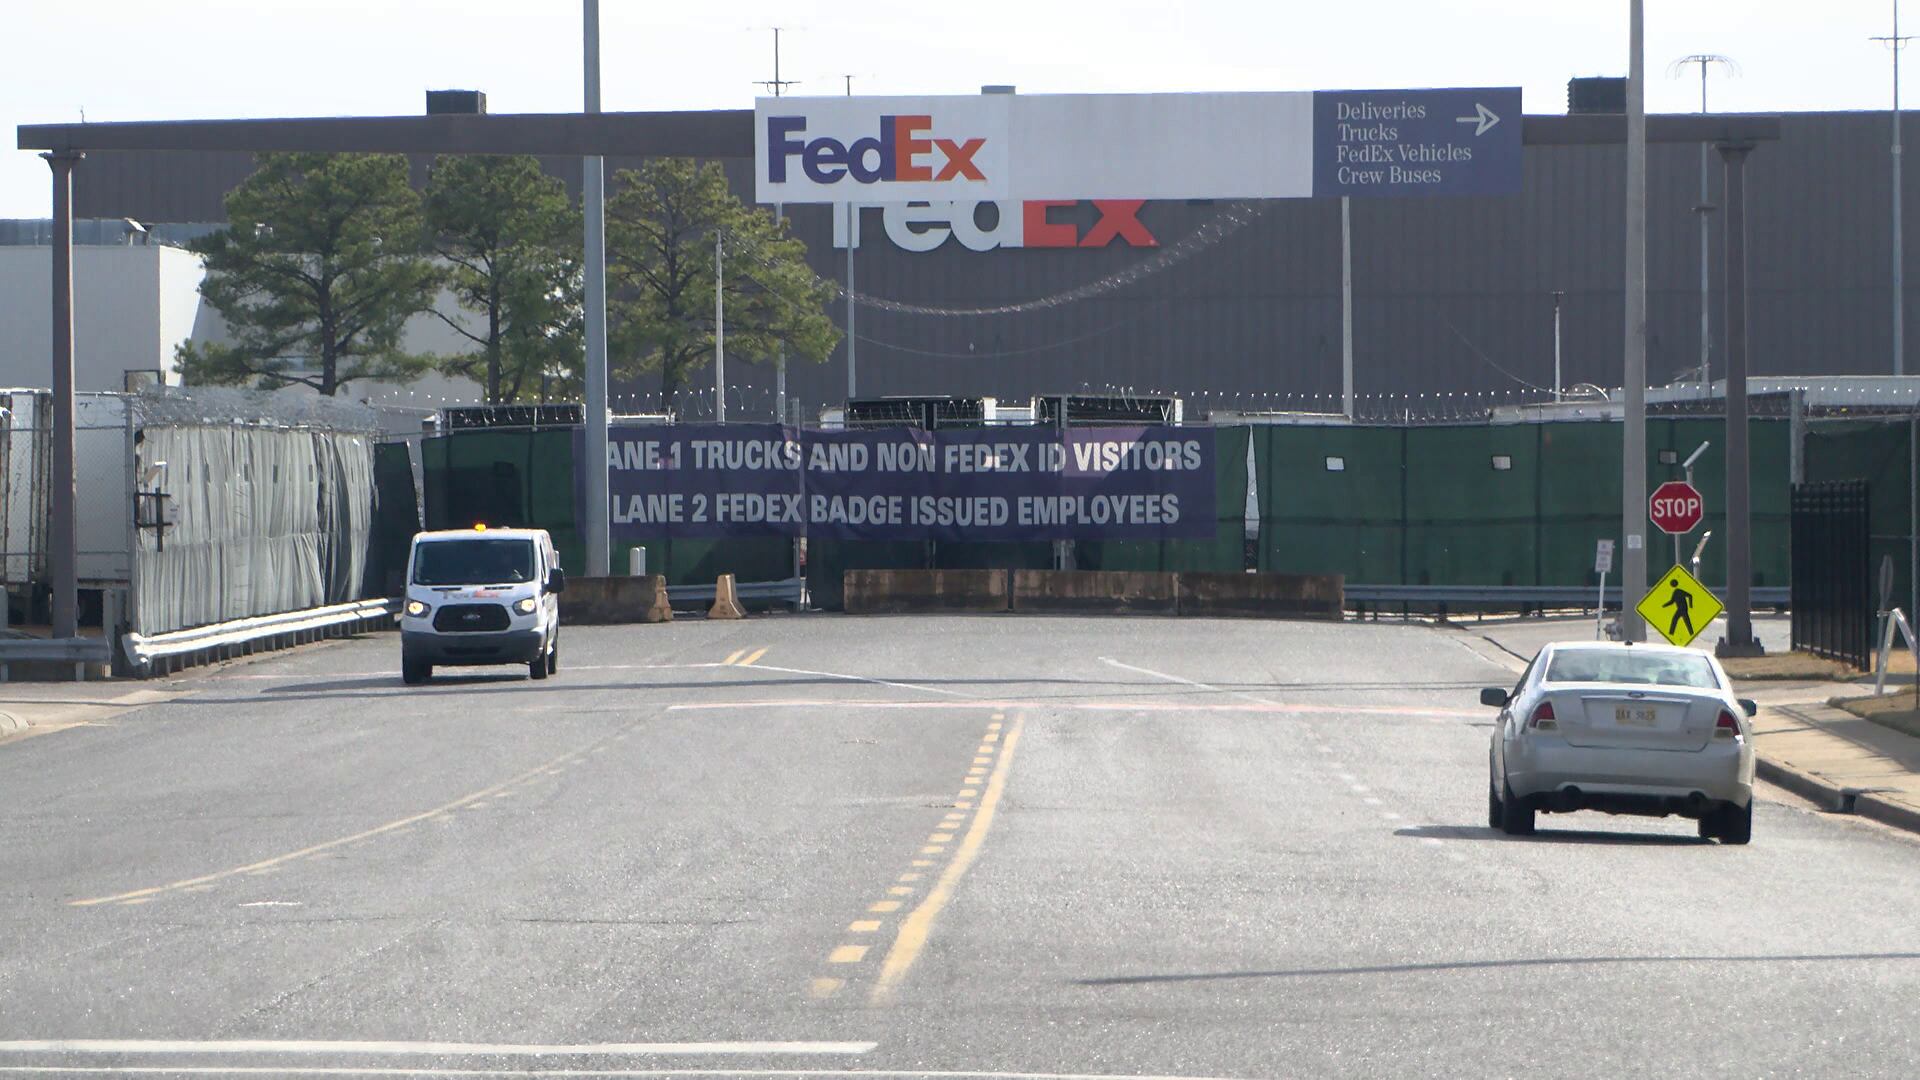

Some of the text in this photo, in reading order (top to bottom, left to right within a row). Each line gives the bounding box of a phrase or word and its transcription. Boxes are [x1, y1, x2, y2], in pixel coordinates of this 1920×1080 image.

[1337, 101, 1426, 120] Deliveries
[1338, 123, 1398, 142] Trucks
[768, 115, 987, 185] FedEx
[1337, 143, 1472, 163] FedEx Vehicles
[1338, 165, 1441, 184] Crew Buses
[607, 440, 1201, 473] ANE 1 TRUCKS AND NON FEDEX ID VISITORS
[613, 493, 1180, 526] LANE 2 FEDEX BADGE ISSUED EMPLOYEES
[1654, 498, 1699, 518] STOP
